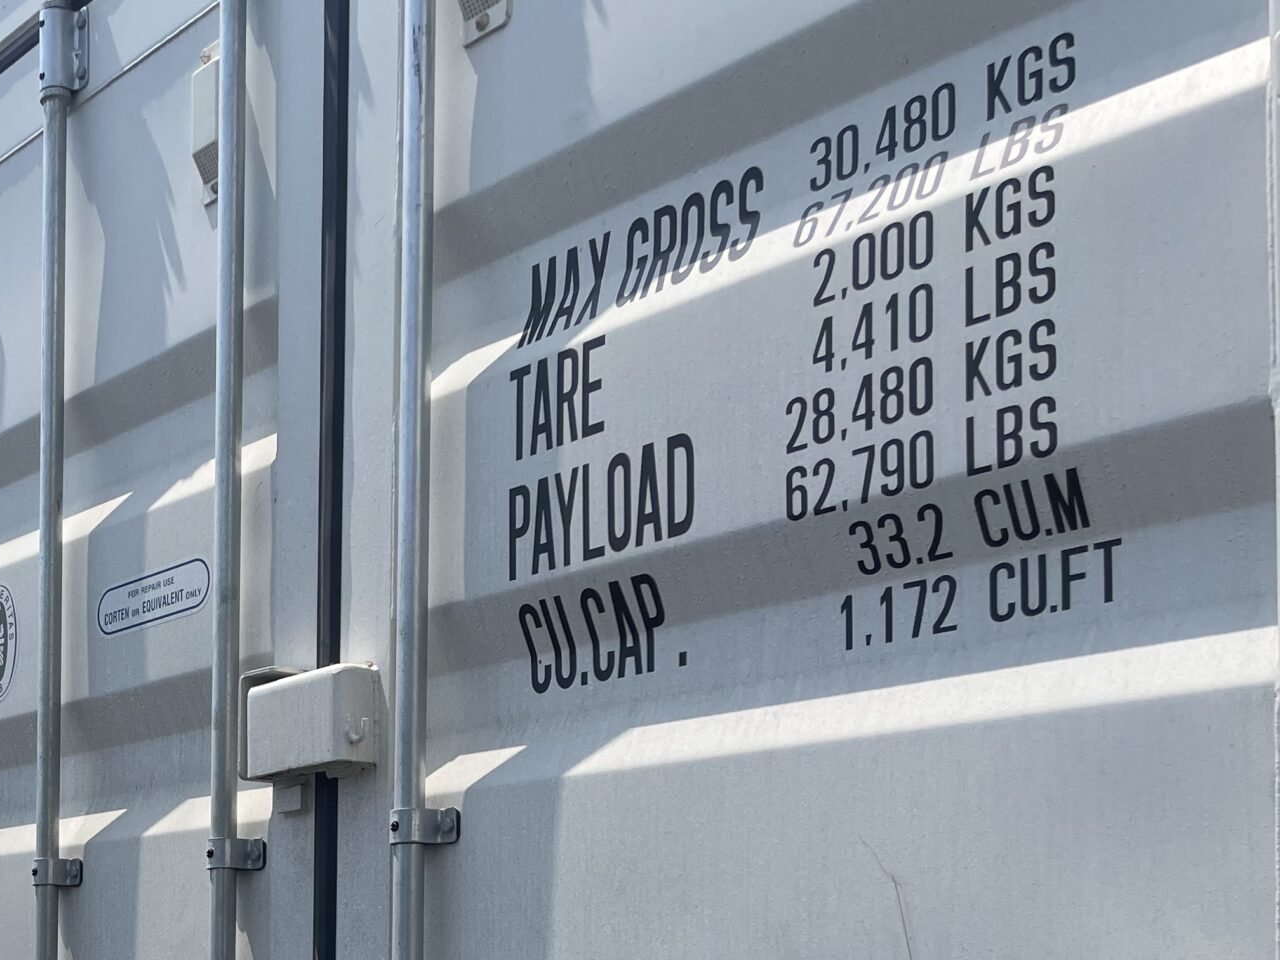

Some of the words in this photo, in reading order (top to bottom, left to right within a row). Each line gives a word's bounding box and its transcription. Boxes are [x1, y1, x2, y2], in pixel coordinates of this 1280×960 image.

[517, 231, 611, 349] MAX
[616, 166, 764, 308] GROSS
[810, 82, 955, 192] 30,480
[986, 32, 1076, 121] KGS
[793, 151, 948, 248] 67,200
[969, 103, 1069, 181] LBS
[510, 334, 606, 461] TARE
[813, 210, 933, 307] 2,000
[965, 165, 1055, 253] KGS
[813, 283, 933, 372] 4,410
[965, 241, 1056, 327] LBS
[509, 433, 695, 581] PAYLOAD
[786, 356, 933, 454] 28,480
[966, 318, 1057, 402] KGS
[786, 430, 934, 521] 62,790
[966, 396, 1057, 477] LBS
[849, 503, 953, 575] 33.2
[974, 467, 1090, 547] CU.M
[104, 606, 129, 626] CORTEN
[142, 589, 184, 614] EQUIVALENT
[185, 588, 202, 600] ONLY
[128, 588, 140, 600] FOR
[141, 582, 161, 596] REPAIR
[162, 576, 175, 591] USE
[841, 575, 957, 651] 1,172
[989, 538, 1122, 622] CU.FT
